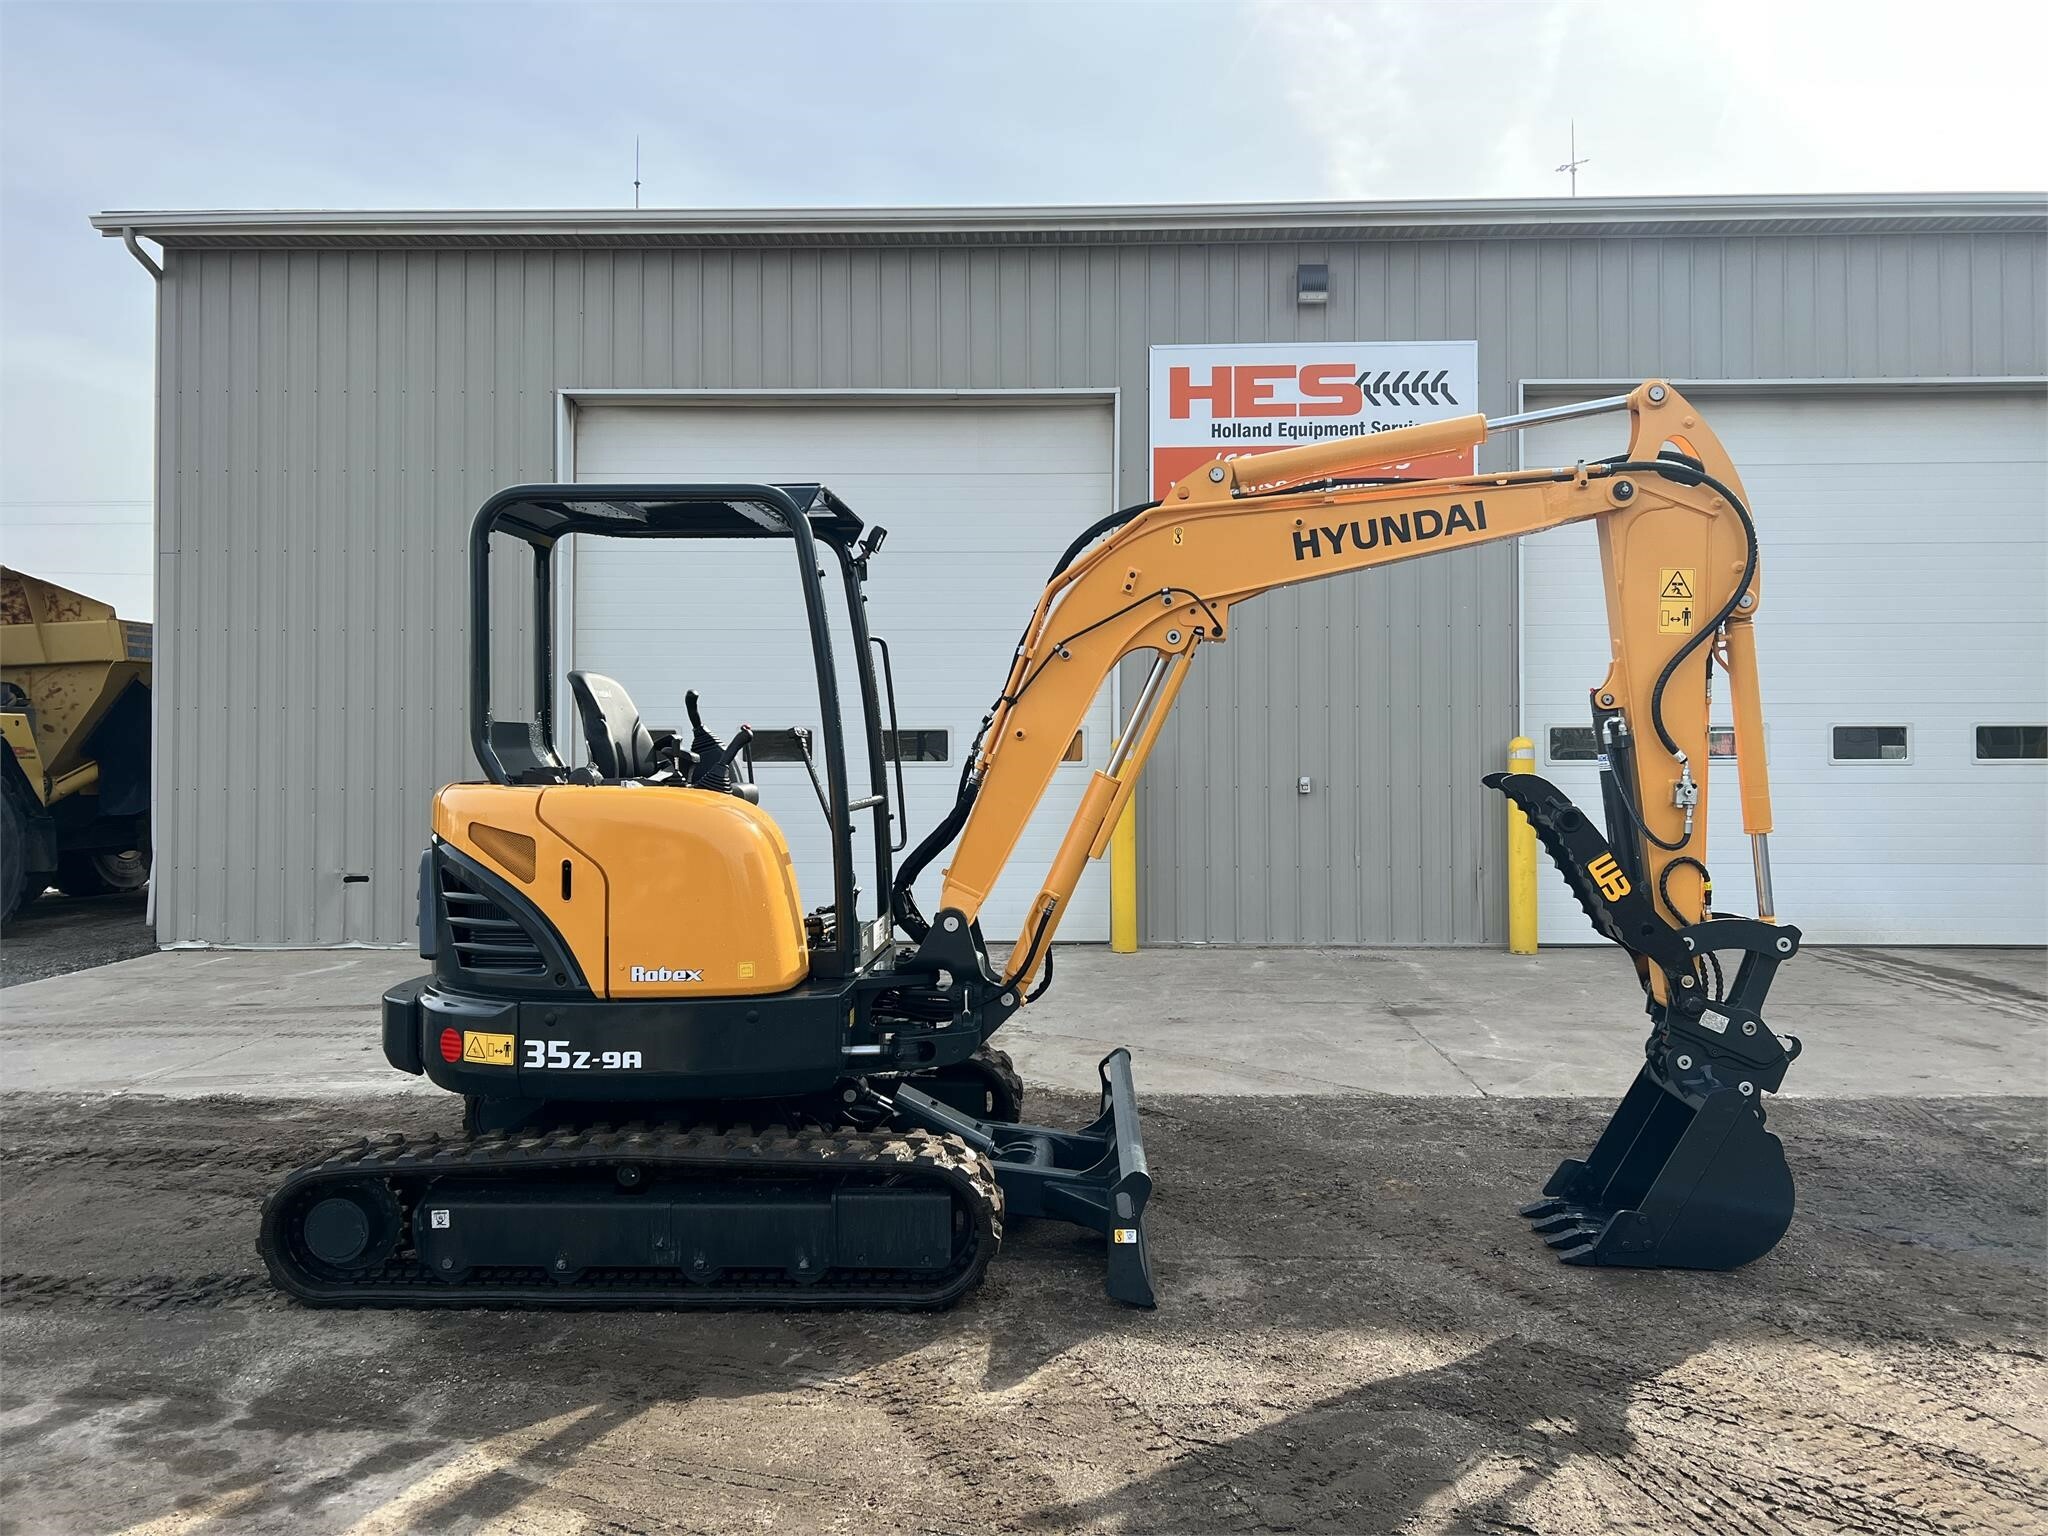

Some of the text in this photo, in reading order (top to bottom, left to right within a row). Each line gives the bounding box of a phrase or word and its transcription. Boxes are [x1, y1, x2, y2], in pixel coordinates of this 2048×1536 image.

[1169, 363, 1363, 419] HES
[1211, 422, 1272, 438] Holland
[1278, 421, 1366, 440] Equipment
[1292, 500, 1487, 561] HYUNDAI
[630, 966, 704, 982] Robex
